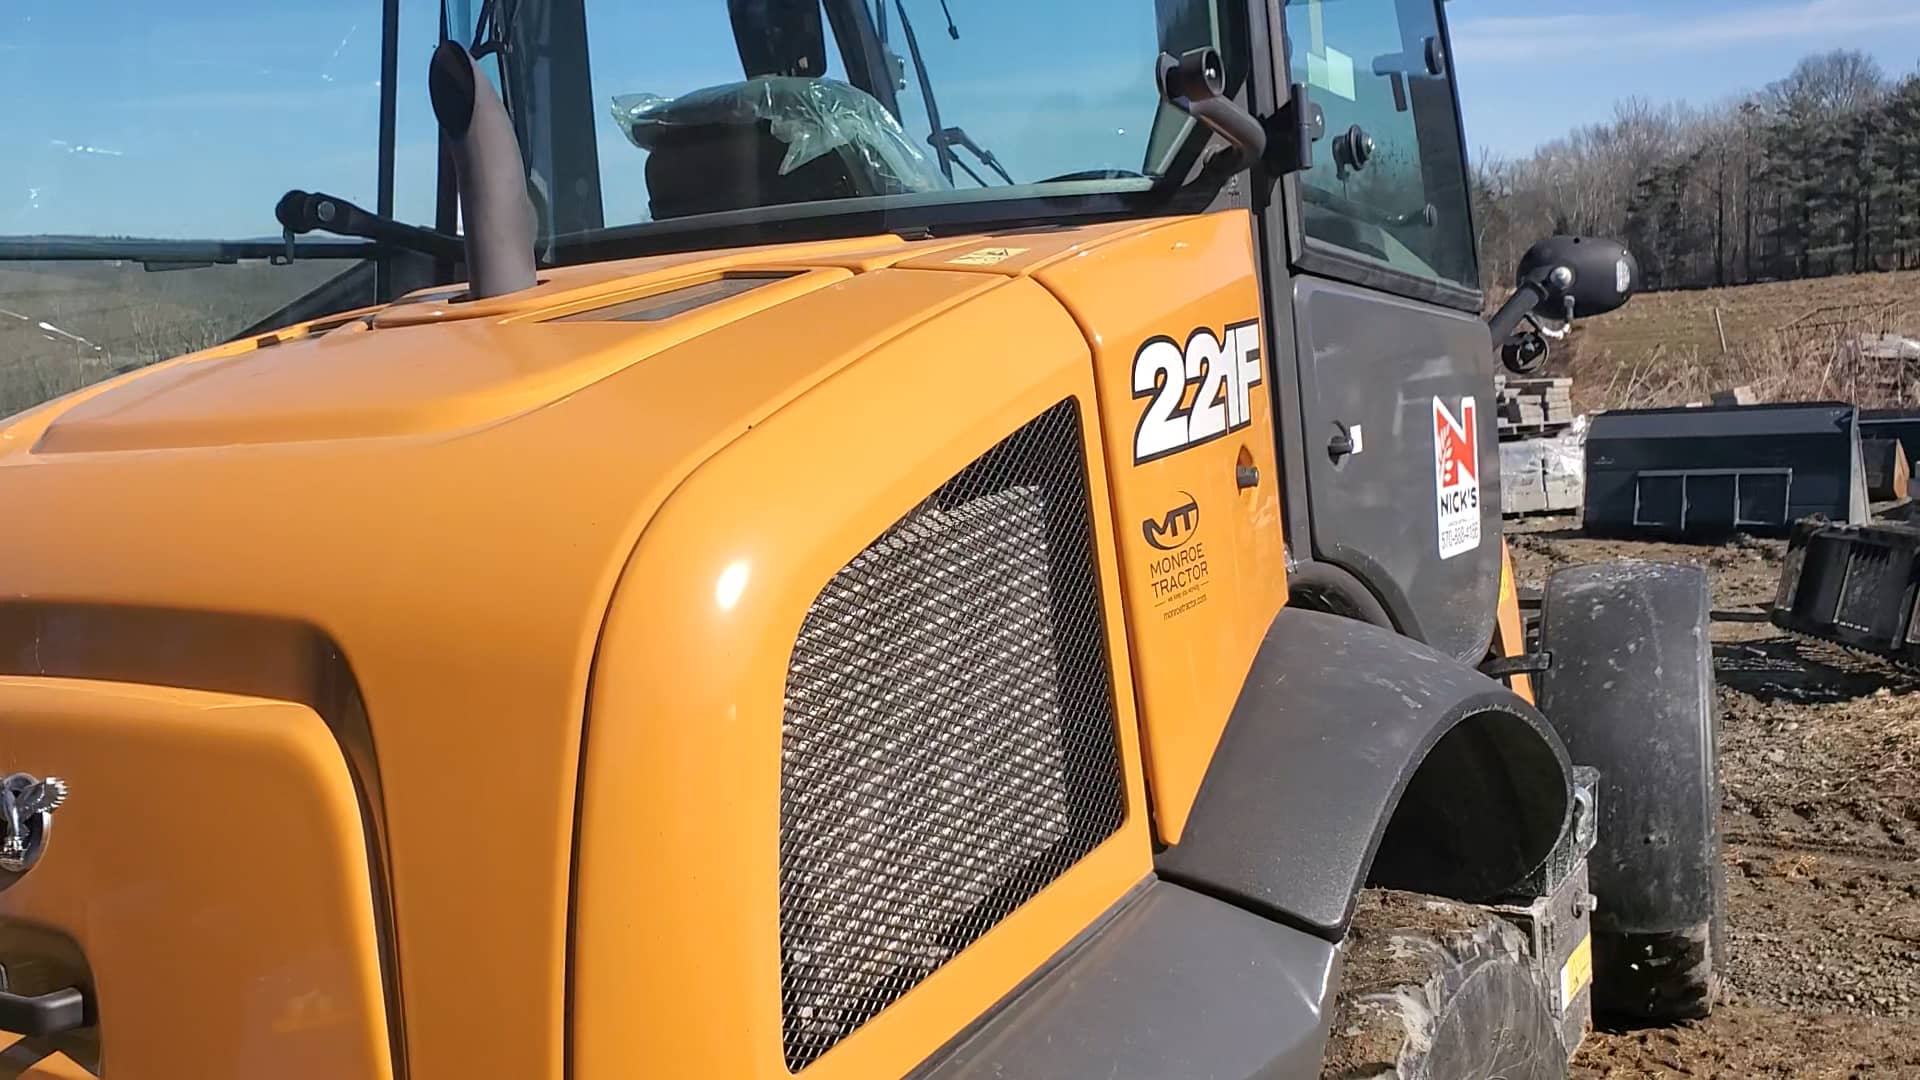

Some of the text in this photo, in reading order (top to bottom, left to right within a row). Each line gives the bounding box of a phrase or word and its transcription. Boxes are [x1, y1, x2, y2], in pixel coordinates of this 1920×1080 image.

[1131, 317, 1262, 467] 221F
[1440, 487, 1477, 516] NICK'S
[1150, 542, 1205, 579] MONROE
[1151, 560, 1209, 599] TRACTOR
